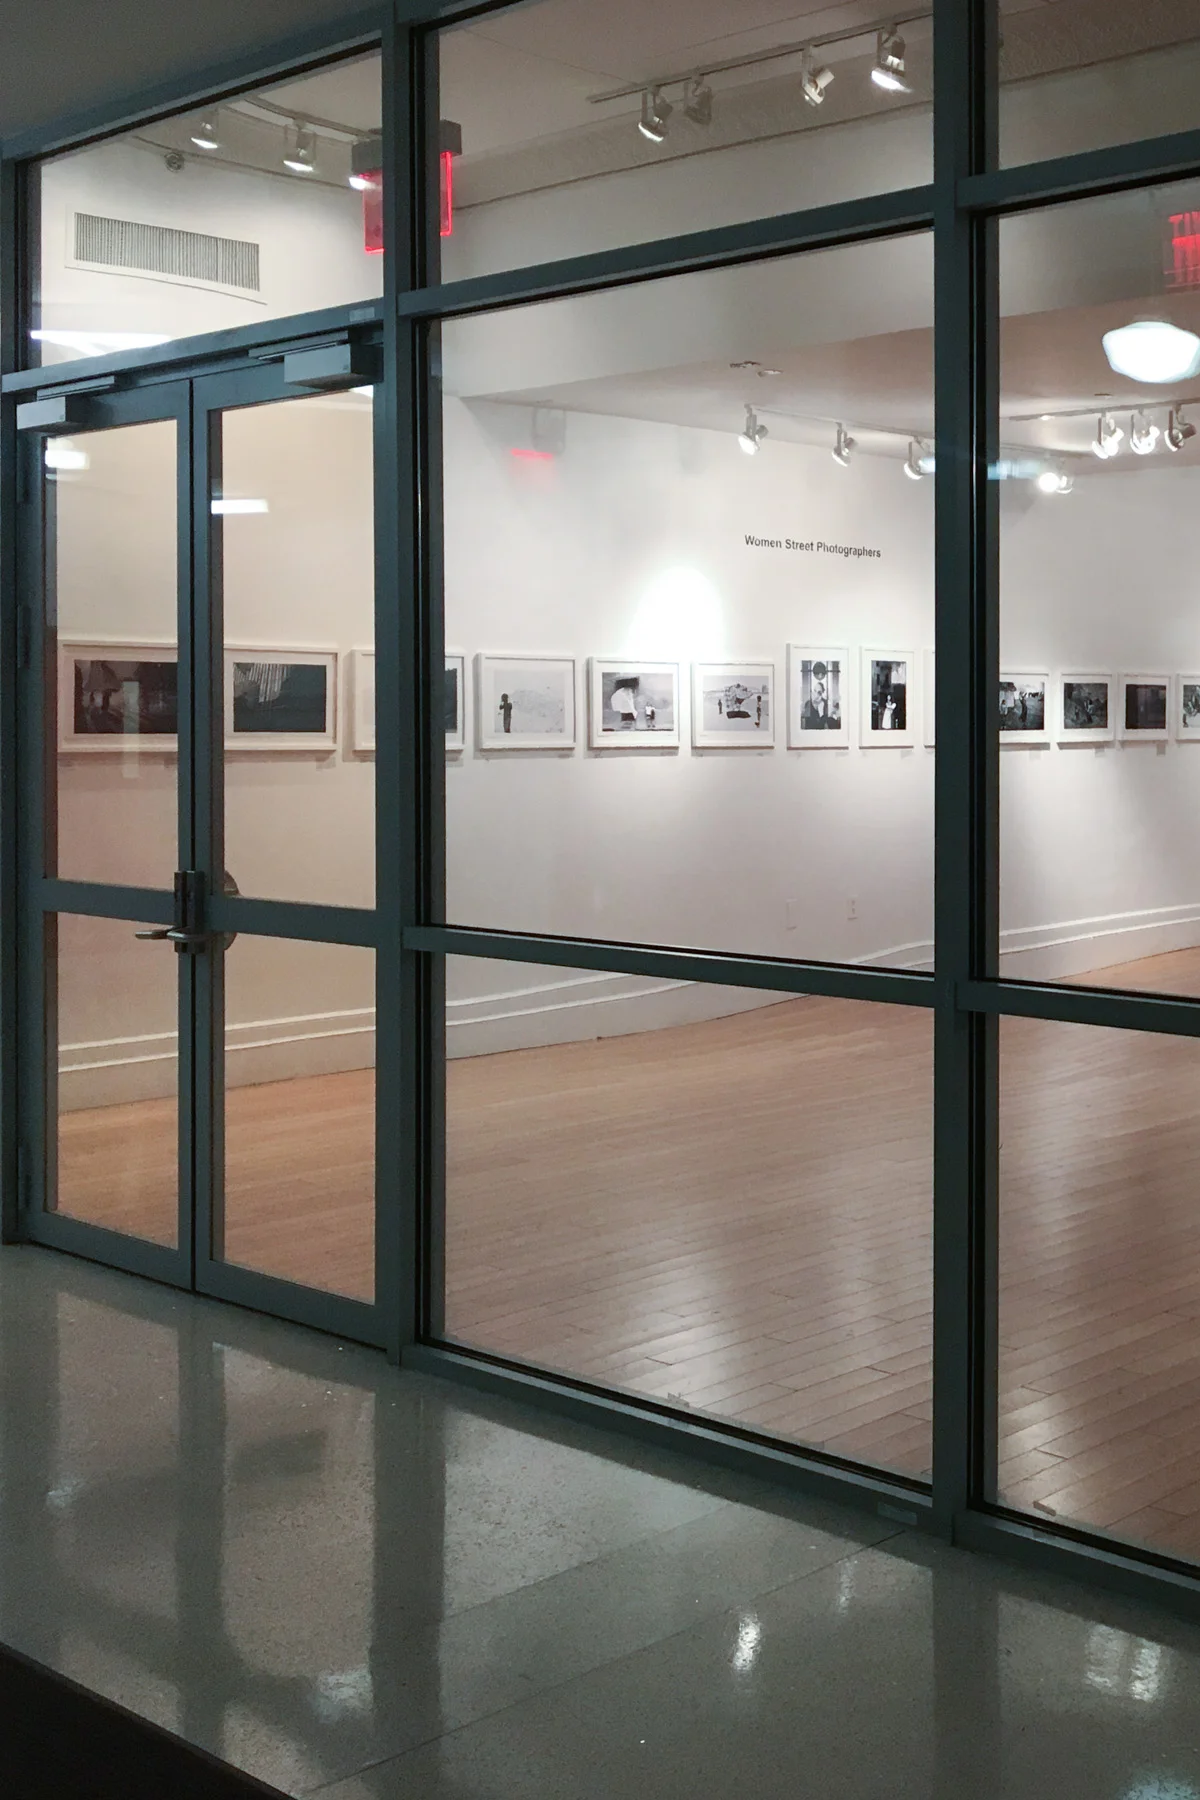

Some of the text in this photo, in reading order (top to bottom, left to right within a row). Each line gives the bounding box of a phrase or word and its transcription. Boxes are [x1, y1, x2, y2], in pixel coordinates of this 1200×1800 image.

[744, 534, 882, 558] Women Street Photographers
